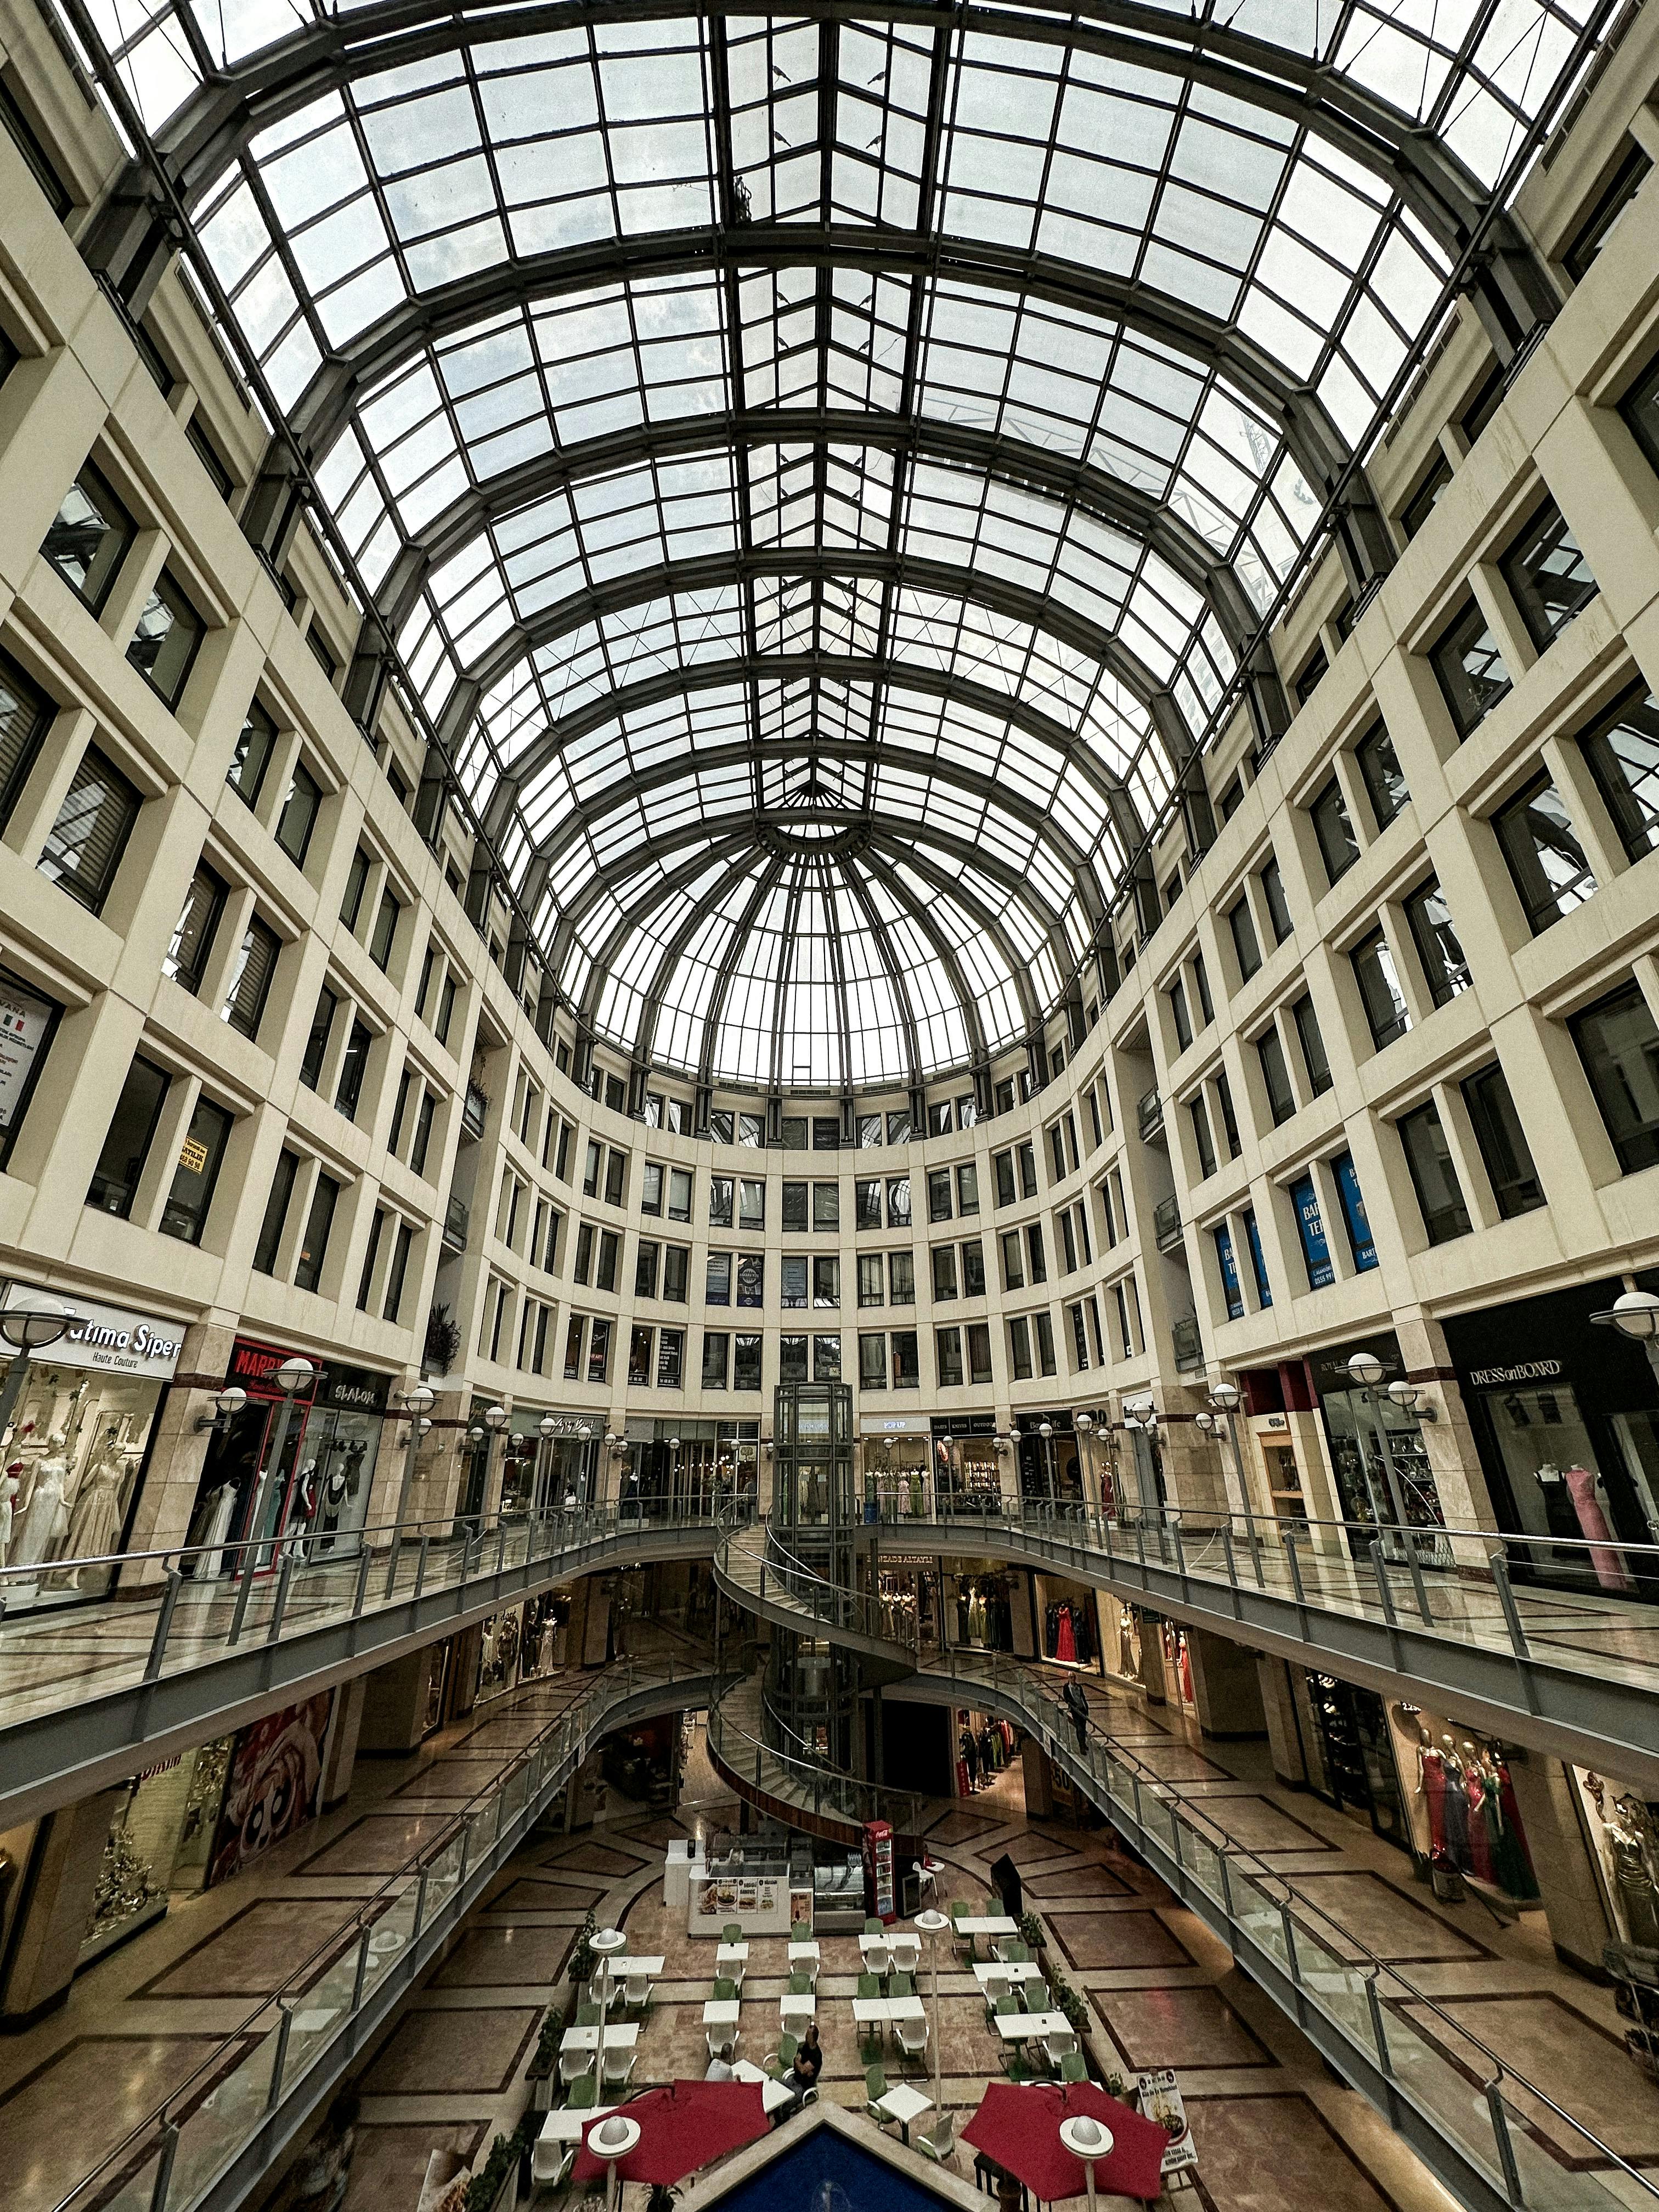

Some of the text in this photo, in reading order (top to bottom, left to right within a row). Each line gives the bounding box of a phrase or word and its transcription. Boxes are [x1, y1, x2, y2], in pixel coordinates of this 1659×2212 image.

[133, 1324, 182, 1358] Siper
[92, 1351, 138, 1368] Haute Couture
[335, 1384, 375, 1404] SLALOM
